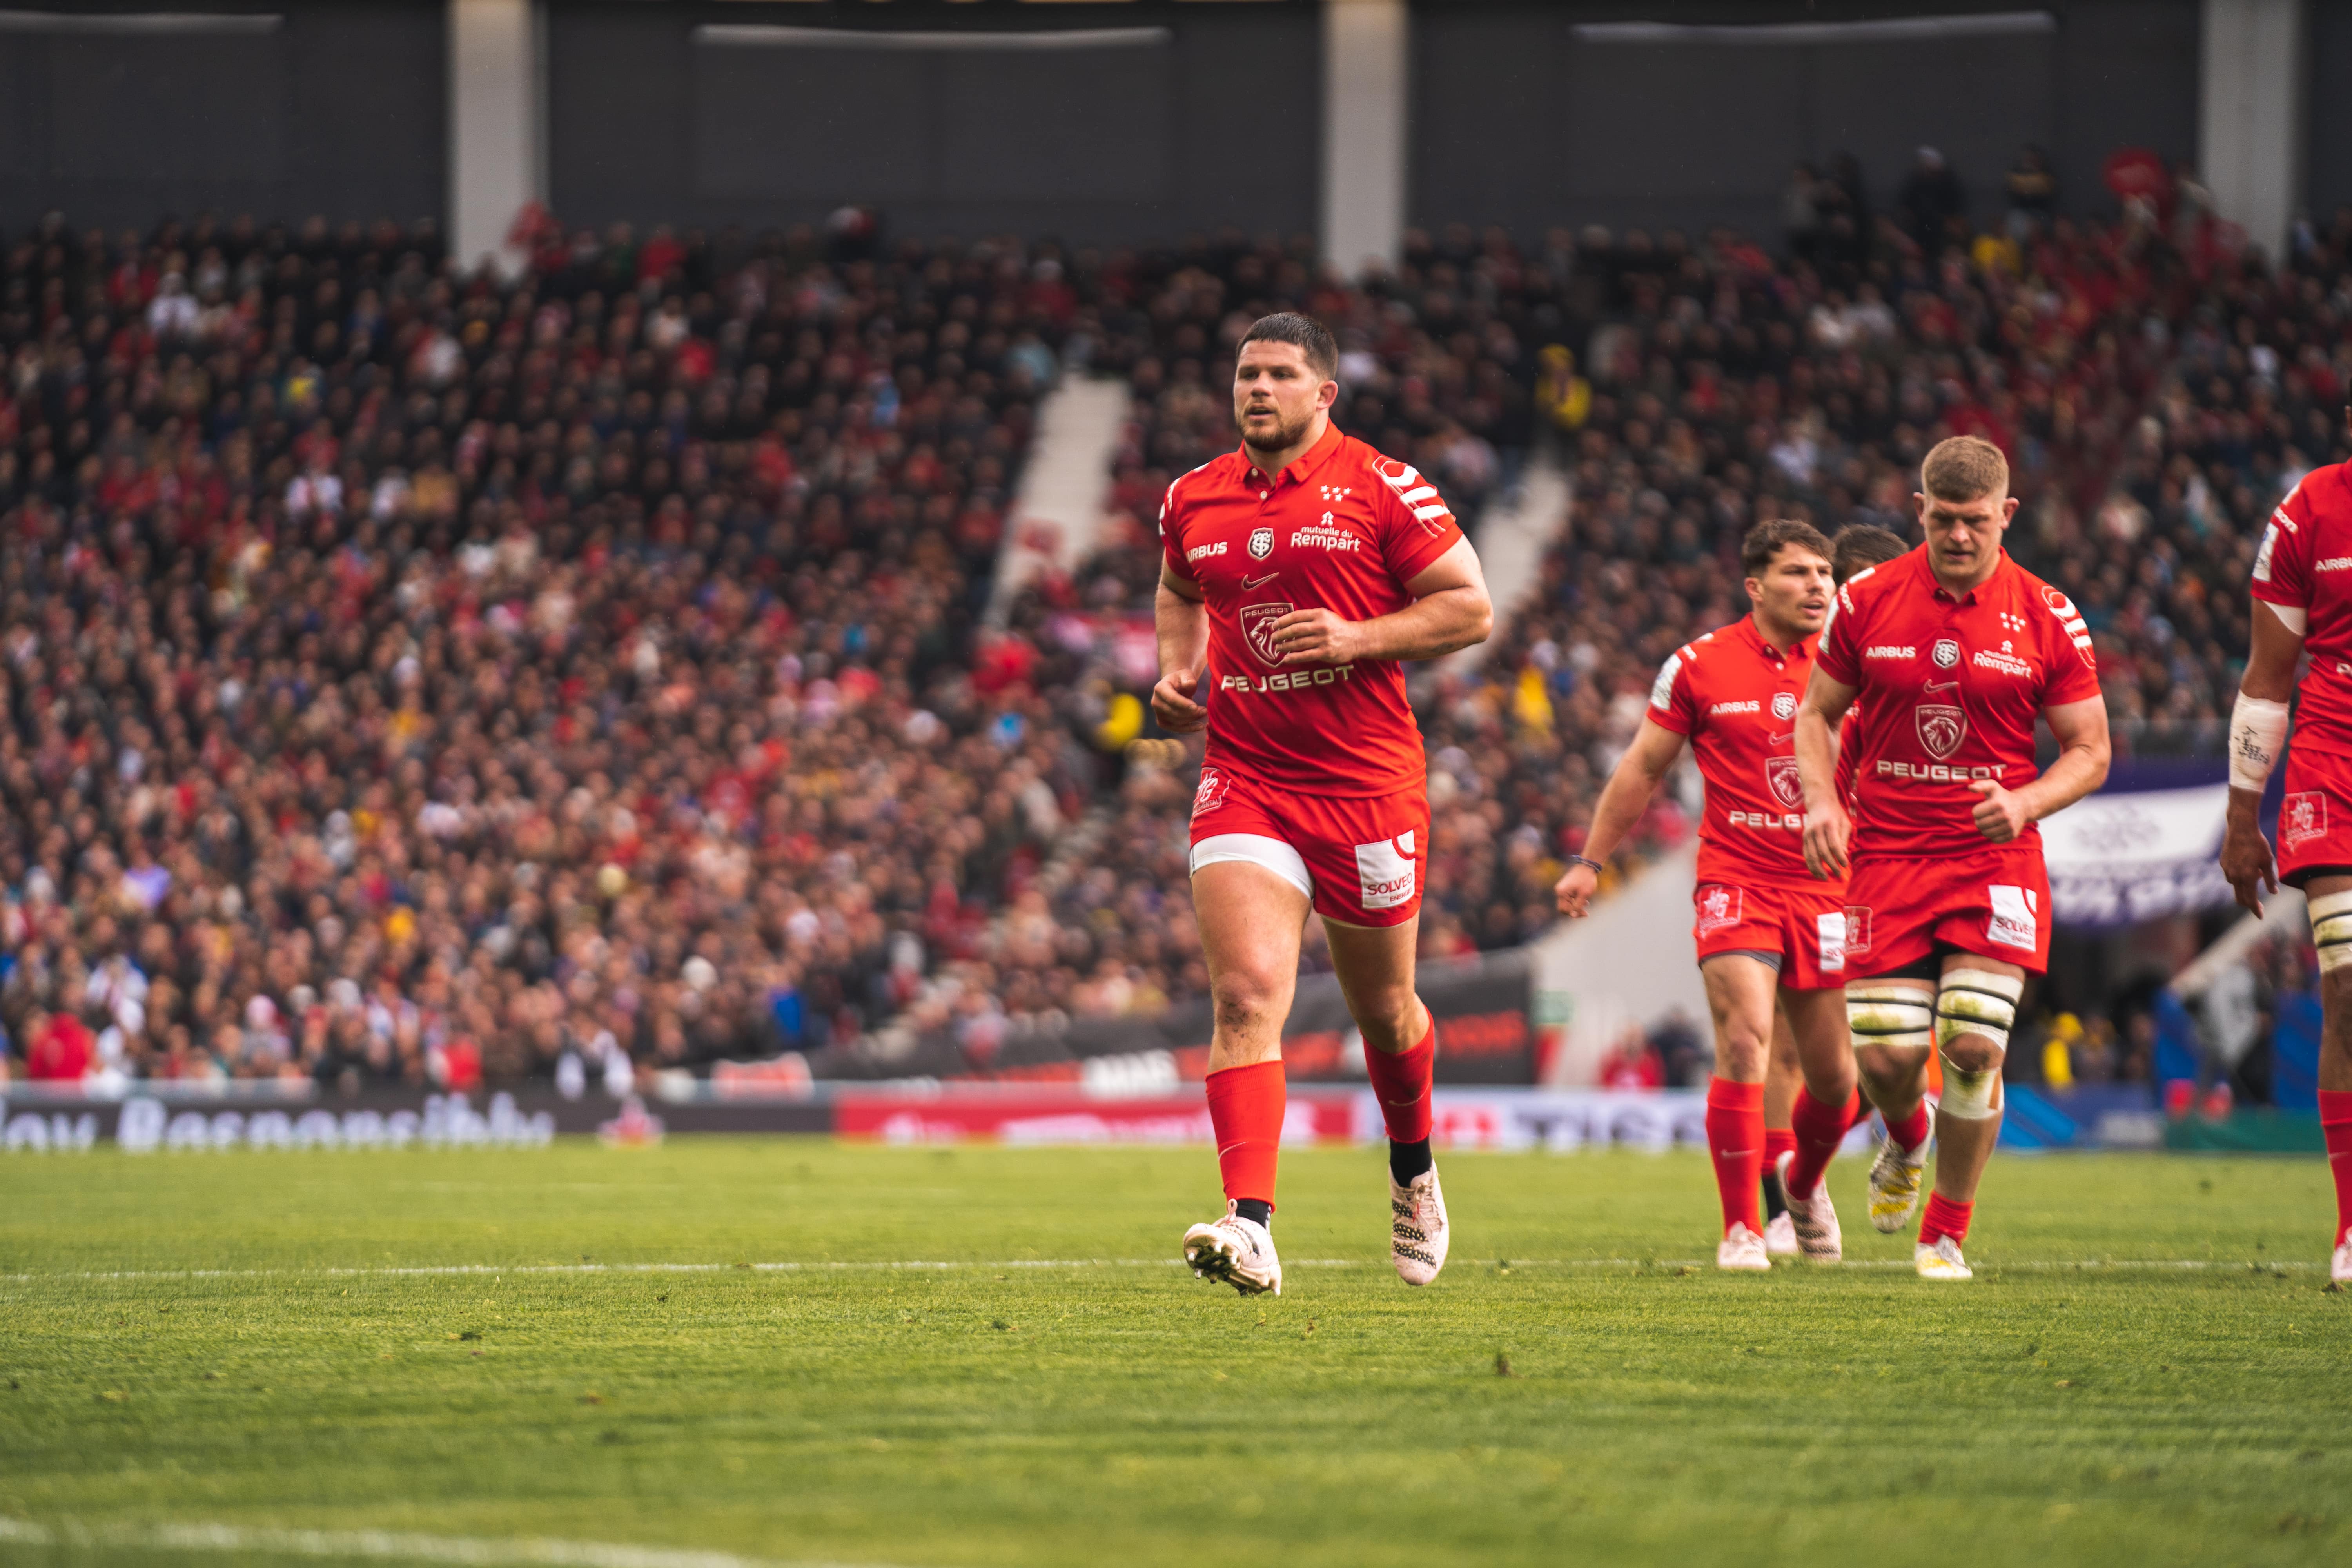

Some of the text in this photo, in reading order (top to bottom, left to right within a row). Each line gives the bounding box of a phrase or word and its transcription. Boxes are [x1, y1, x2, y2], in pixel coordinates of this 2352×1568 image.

[1301, 525, 1352, 538] mutuelle du
[1290, 532, 1361, 553] Rempart
[1245, 607, 1290, 619] PEUGEOT
[1866, 646, 1916, 659] AIRBUS
[1973, 652, 2033, 680] Rempart
[1220, 664, 1354, 694] PEUGEOT
[1710, 700, 1760, 716] AIRBUS
[1877, 760, 2007, 780] PEUGEOT
[1729, 810, 1806, 829] PEUG
[1367, 872, 1412, 895] SOLVEO
